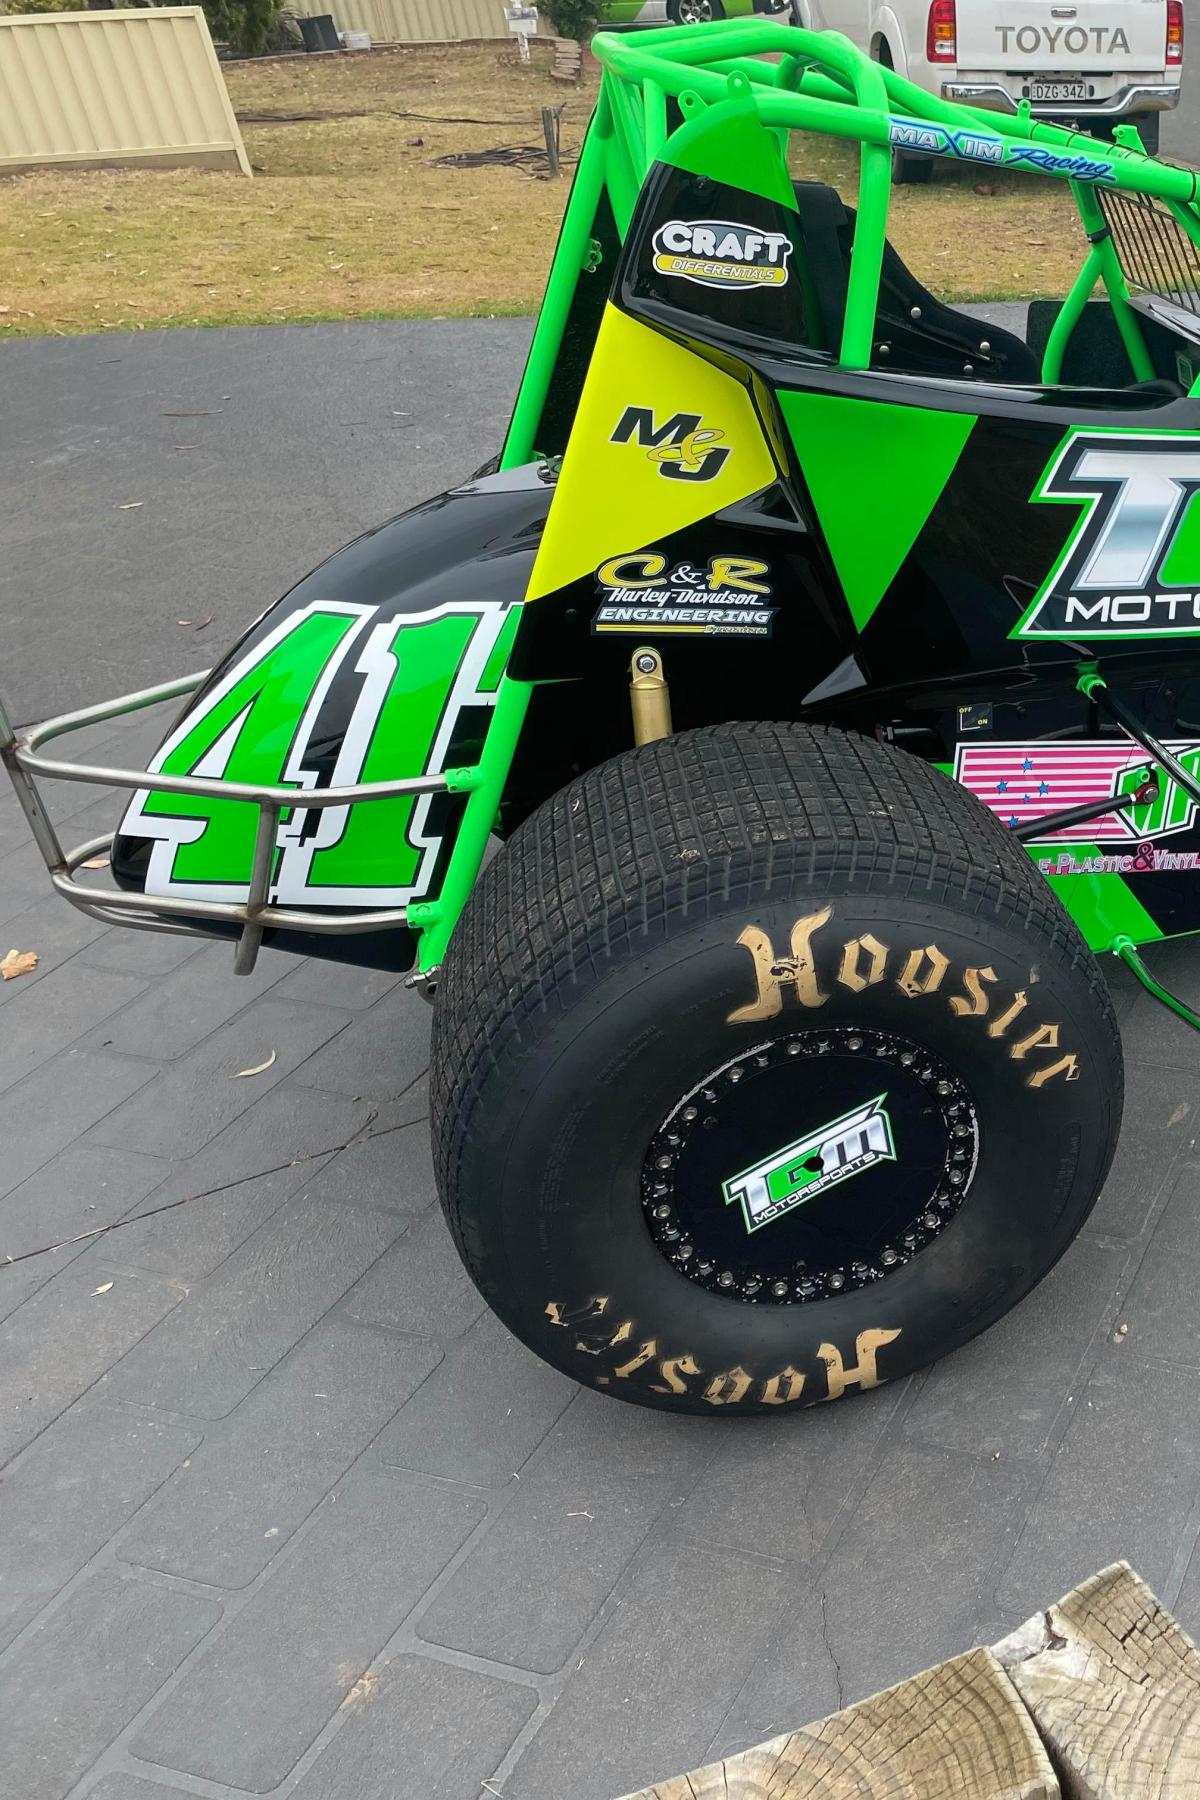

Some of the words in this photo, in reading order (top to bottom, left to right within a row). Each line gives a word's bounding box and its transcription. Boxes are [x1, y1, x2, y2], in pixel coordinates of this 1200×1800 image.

[995, 26, 1131, 54] TOYOTA
[888, 118, 1003, 164] MAXIM
[1005, 146, 1116, 182] Racing
[662, 224, 785, 262] CRAFT
[671, 259, 776, 280] DIFFERENTIALS
[598, 554, 667, 588] C
[670, 565, 702, 585] &
[706, 557, 770, 593] R
[603, 585, 764, 607] Harley-Davidson
[599, 608, 770, 623] ENGINEERING
[958, 706, 973, 714] OFF
[726, 905, 1080, 1088] Hoosier
[753, 1151, 876, 1224] MOTORSPORTS
